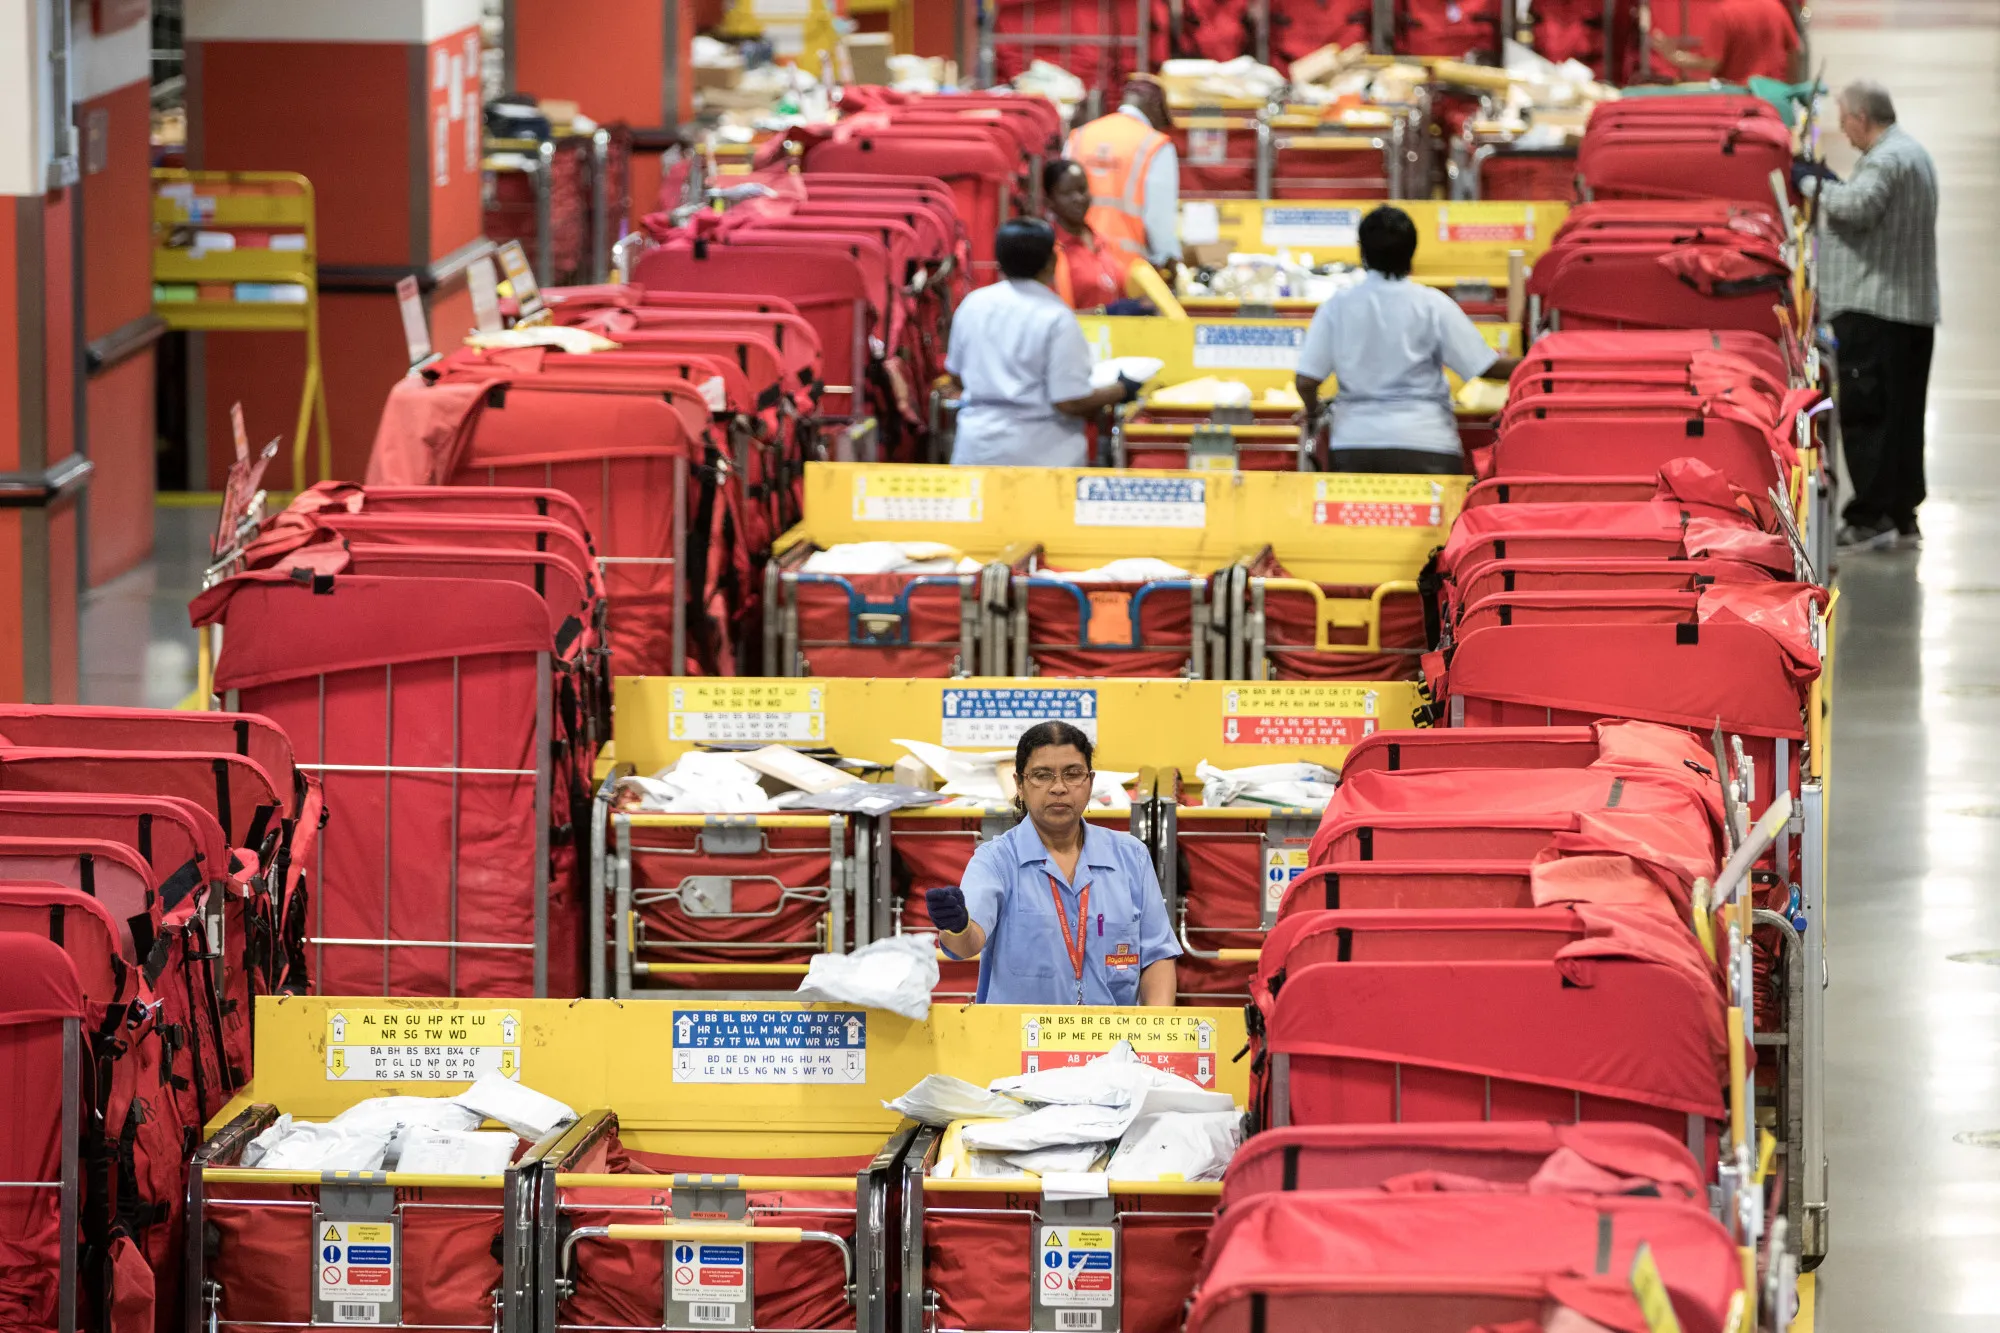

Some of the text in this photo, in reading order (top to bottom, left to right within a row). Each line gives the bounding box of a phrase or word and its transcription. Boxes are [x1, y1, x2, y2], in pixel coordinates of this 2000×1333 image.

[362, 1015, 485, 1025] AL EN GU HP KT LU
[692, 1013, 844, 1022] B BB BL BX9 CH CV CW DY FY
[1039, 1016, 1200, 1025] BN BX5 BR CB CM CO CR CT DA
[336, 1028, 342, 1036] 4
[506, 1029, 512, 1037] 4
[681, 1029, 687, 1037] 2
[697, 1025, 840, 1034] HR L LA LL M MK OL PR SK
[381, 1029, 466, 1039] NR SG TW WD
[850, 1030, 856, 1038] 2
[1030, 1033, 1036, 1041] 5
[1042, 1031, 1196, 1041] IG IP ME PE RH RM SM SS TN
[696, 1036, 839, 1046] ST SY TF WA WN WV WR WS
[1201, 1035, 1207, 1043] 5
[369, 1046, 480, 1055] BA BH BS BX1 BX4 CF
[374, 1058, 474, 1066] DT GL LD NP OX PO
[707, 1054, 830, 1063] BD DE DN HD HG HU HX
[1068, 1054, 1080, 1063] AB
[1140, 1054, 1169, 1064] DL EX
[336, 1060, 341, 1068] 3
[506, 1060, 511, 1068] 3
[681, 1061, 687, 1069] 1
[849, 1062, 855, 1070] 1
[375, 1070, 474, 1078] RG SA SN SO SP TA
[704, 1066, 715, 1074] LE
[720, 1066, 732, 1074] LN
[738, 1066, 750, 1074] LS
[754, 1066, 768, 1074] NG
[792, 1066, 798, 1075] S
[802, 1066, 816, 1074] WF
[821, 1066, 834, 1075] YO
[1201, 1067, 1206, 1075] B
